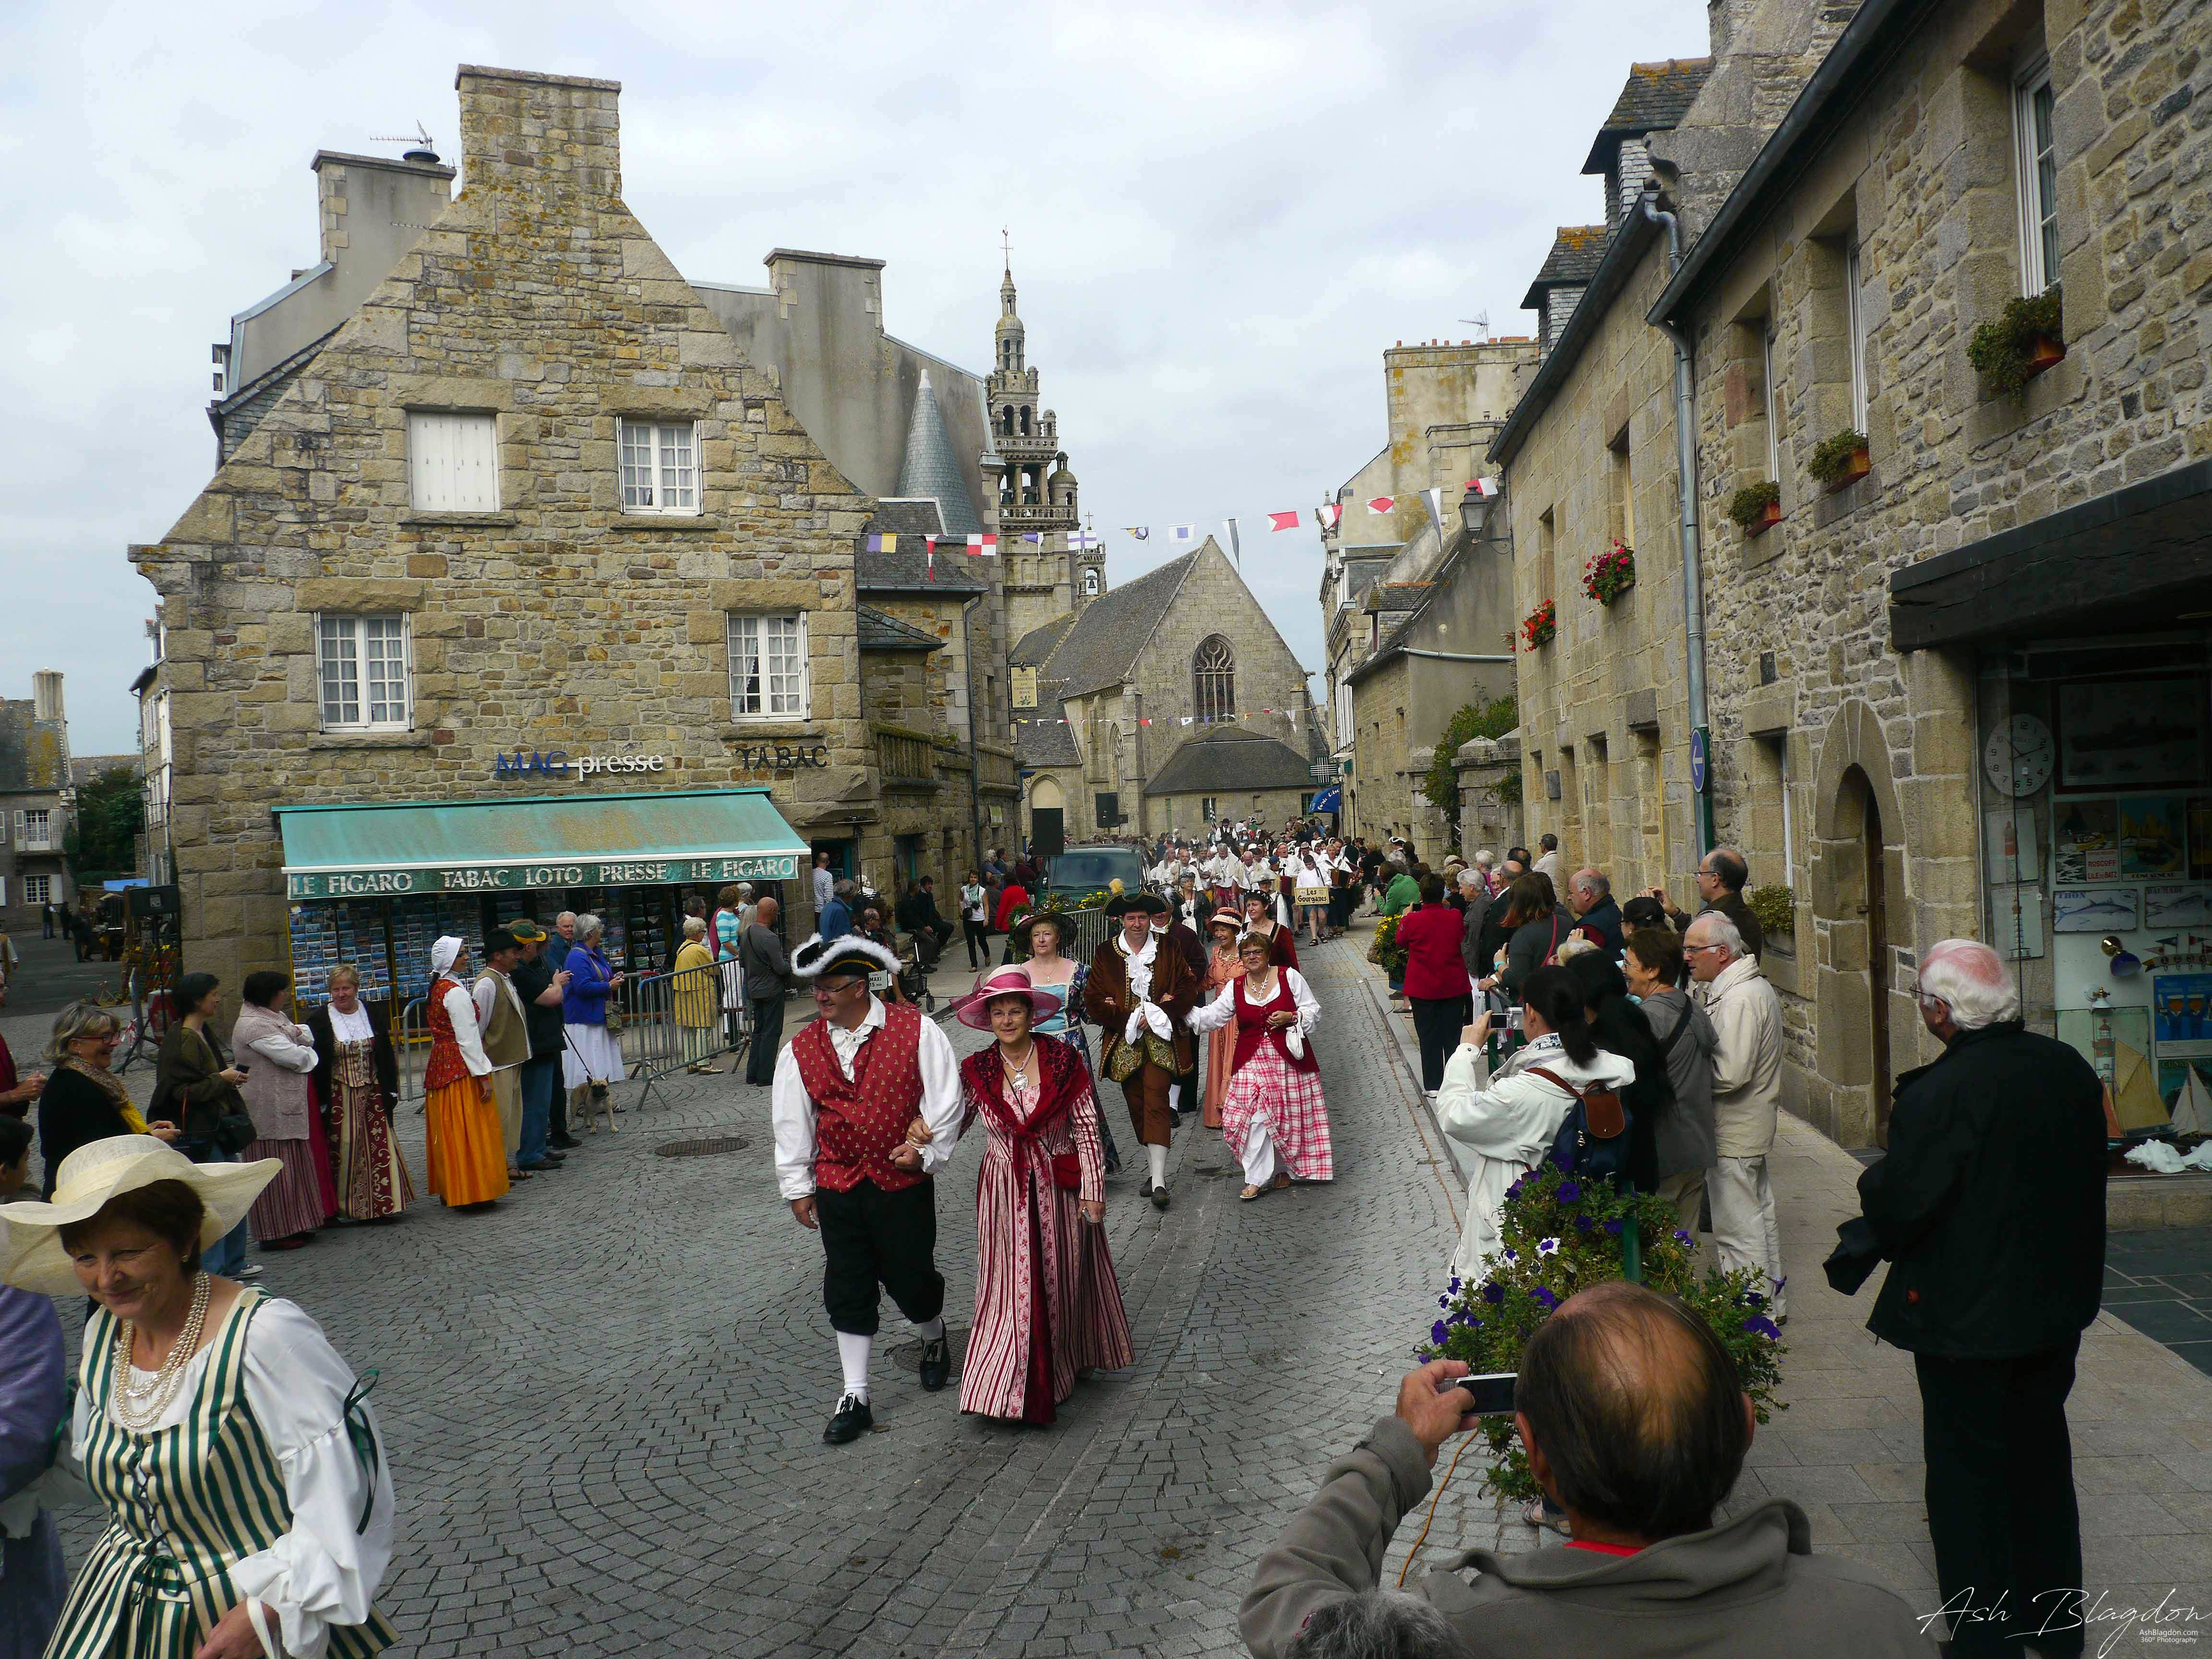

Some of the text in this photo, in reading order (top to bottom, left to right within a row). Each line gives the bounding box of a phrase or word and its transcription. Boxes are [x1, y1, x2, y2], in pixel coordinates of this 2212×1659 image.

[2020, 721, 2028, 730] 12
[735, 745, 827, 769] TABAC
[1991, 748, 1997, 757] 9
[496, 751, 664, 781] MAG presse
[2088, 859, 2116, 868] ROSCOFF
[291, 857, 794, 895] LE FIGARO TABAC LOTO PRESSE LE FIGARO
[1298, 895, 1327, 903] Gourganes
